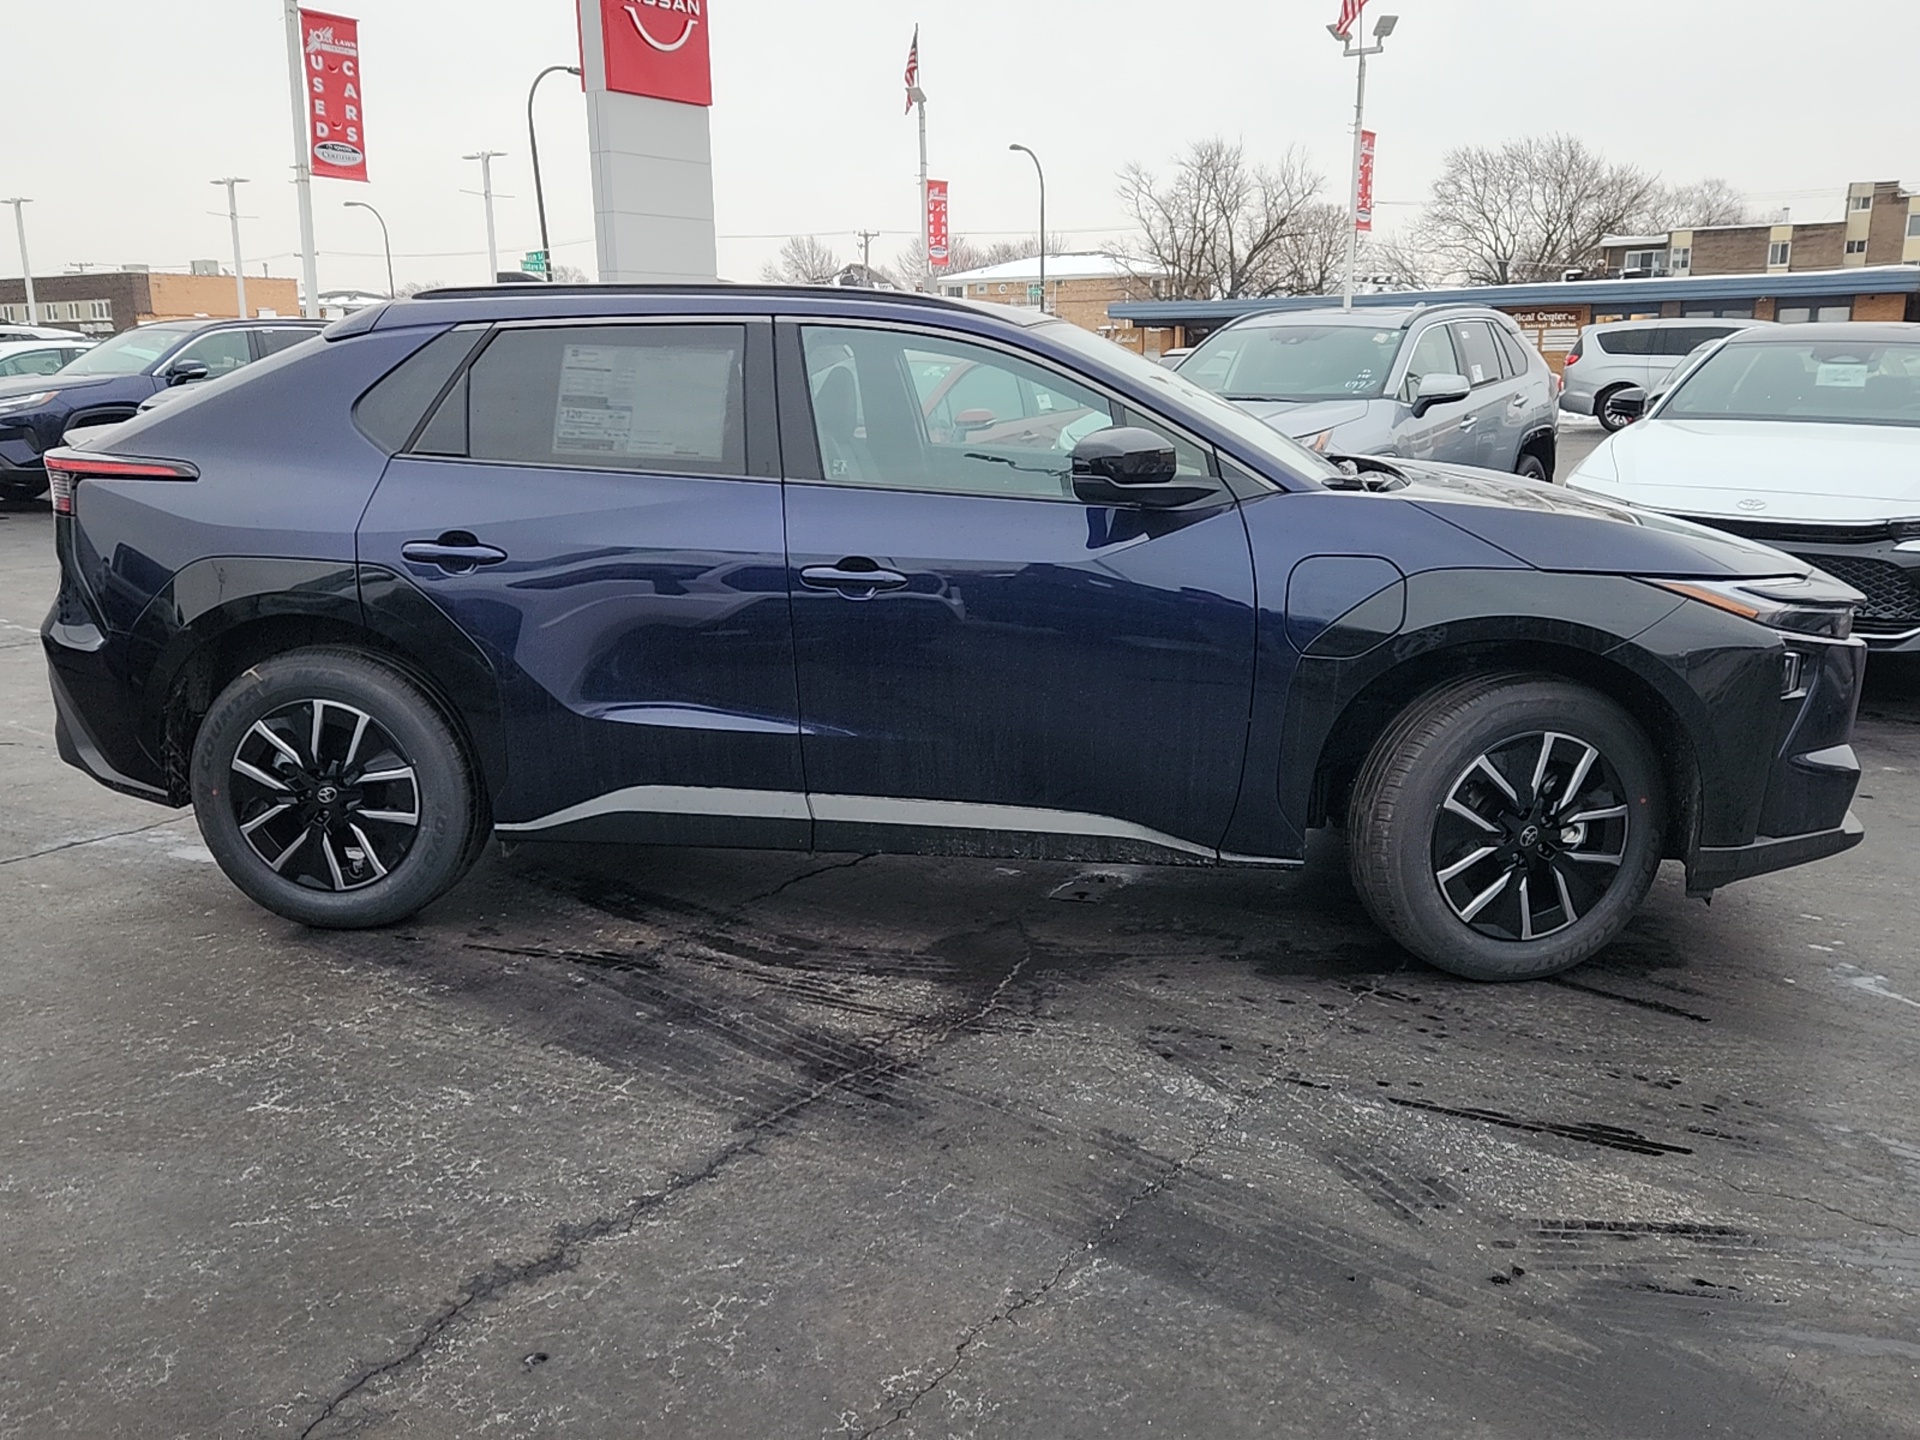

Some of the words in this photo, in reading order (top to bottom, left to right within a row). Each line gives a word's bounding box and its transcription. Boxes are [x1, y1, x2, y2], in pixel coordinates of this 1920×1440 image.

[631, 0, 700, 16] SAN
[310, 54, 329, 138] USED
[342, 60, 358, 142] CARS
[1512, 312, 1536, 321] dical
[1537, 311, 1568, 322] Center
